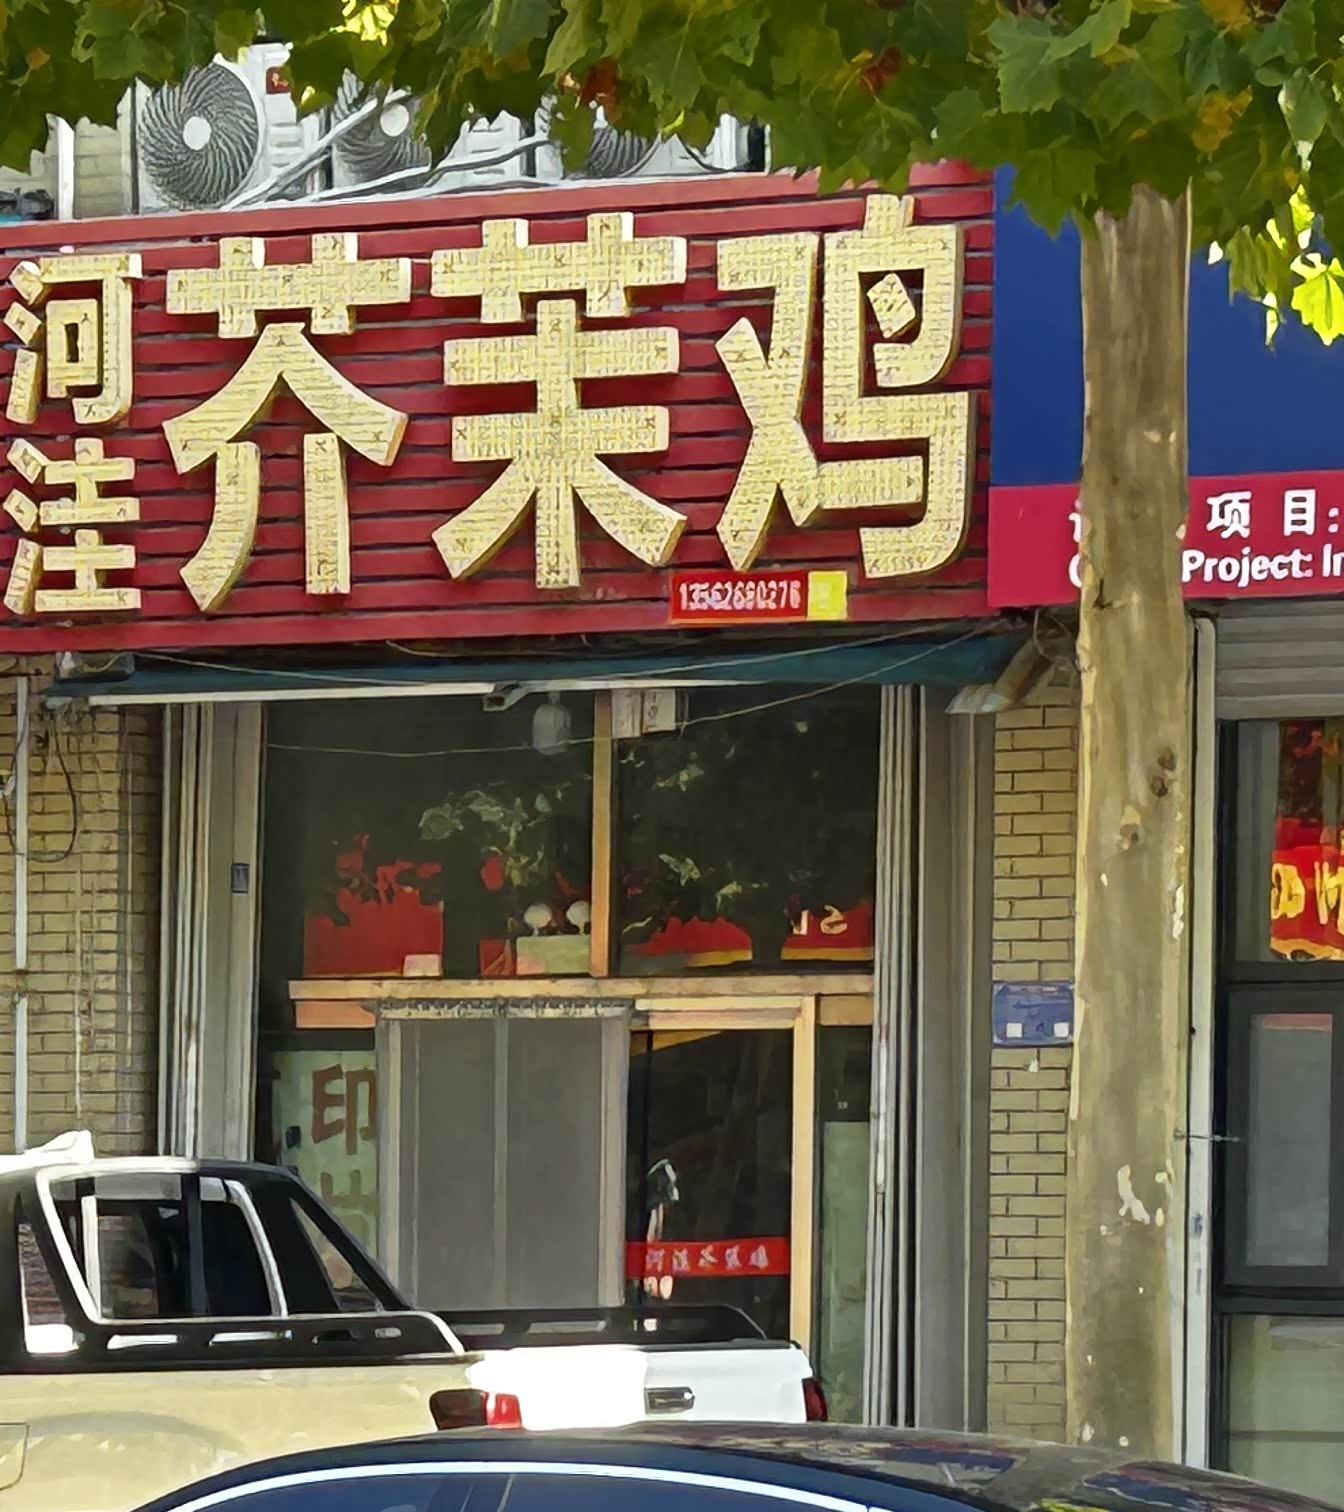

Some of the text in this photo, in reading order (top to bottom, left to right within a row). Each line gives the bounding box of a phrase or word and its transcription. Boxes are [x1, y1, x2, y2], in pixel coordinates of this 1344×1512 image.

[2, 253, 143, 616] 河洼
[162, 192, 981, 613] 芥茉鸡
